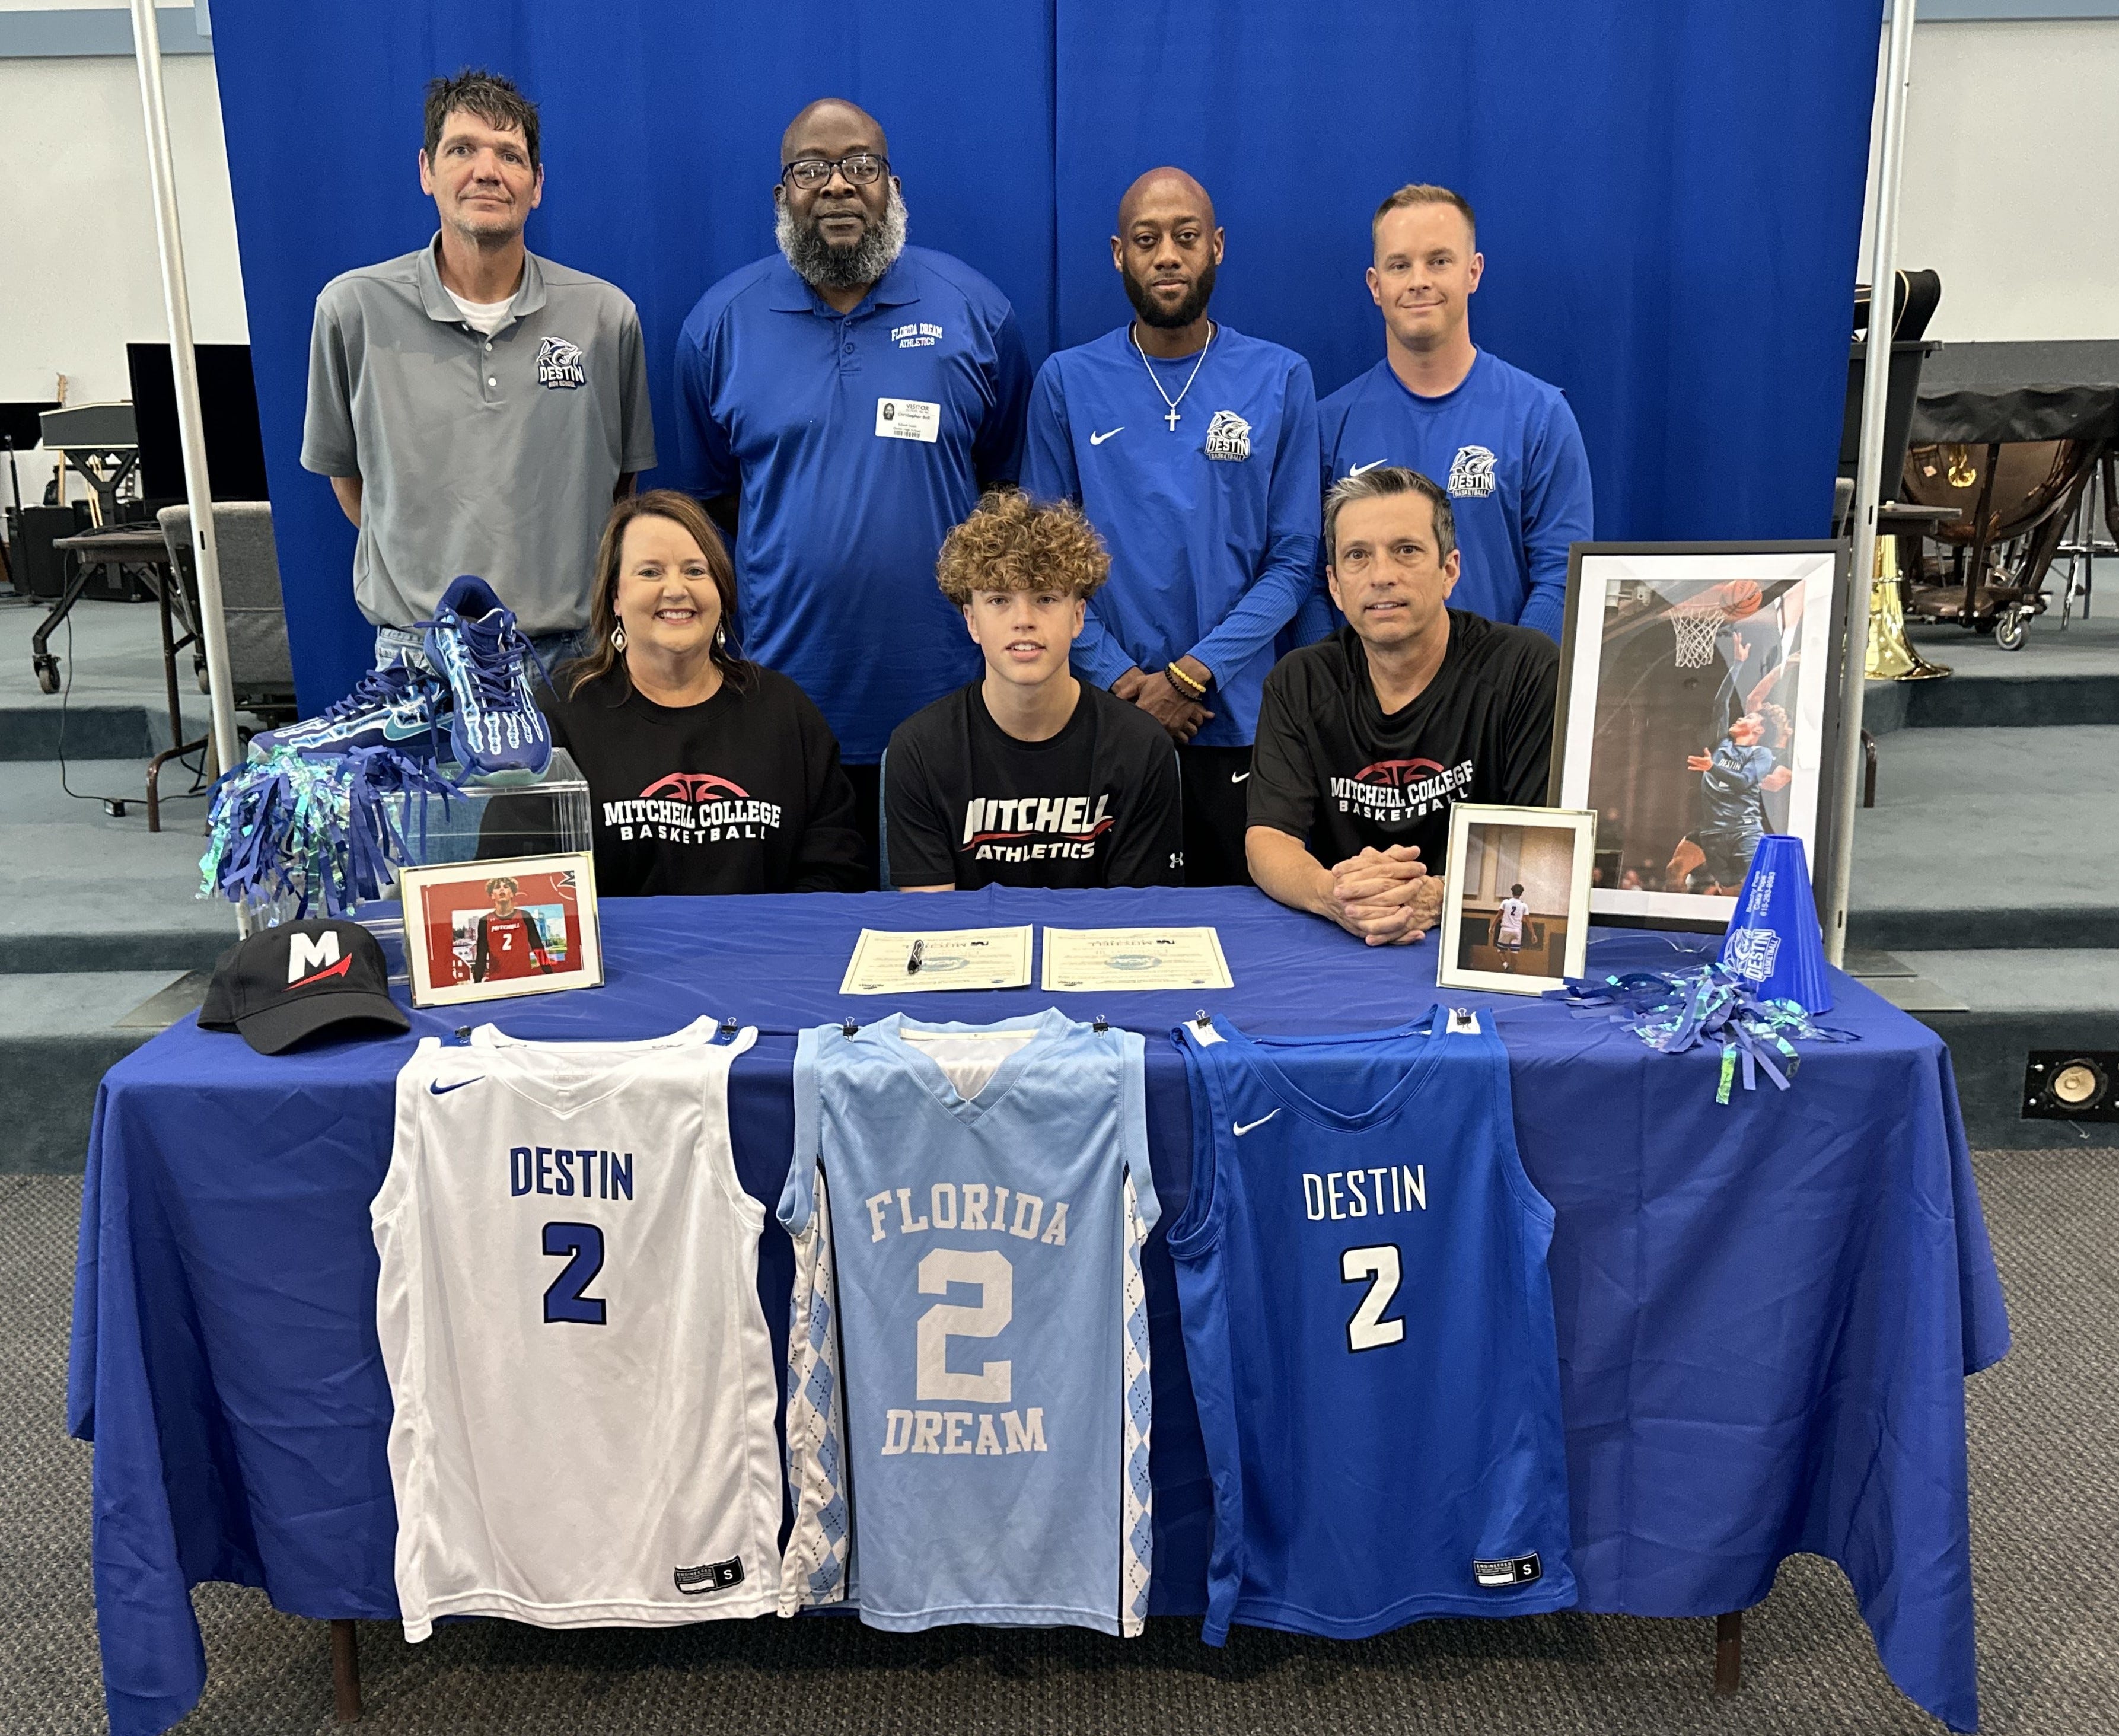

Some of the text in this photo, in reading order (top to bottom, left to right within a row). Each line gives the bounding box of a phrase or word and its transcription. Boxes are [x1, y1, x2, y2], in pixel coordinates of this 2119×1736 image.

[891, 323, 942, 341] FLORIDA DREAM
[899, 337, 935, 348] ATHLETICS
[540, 365, 584, 383] DESTIN
[1206, 438, 1248, 457] DESTIN
[1449, 473, 1493, 491] DESTIN
[1717, 758, 1742, 771] DESTIN
[1330, 777, 1406, 807] MITCHELL
[603, 800, 782, 829] MITCHELL COLLEGE
[1339, 787, 1468, 821] BASKETBALL
[620, 824, 765, 844] BASKETBALL
[975, 841, 1095, 862] ATHLETICS
[1510, 906, 1516, 916] 2
[491, 923, 520, 932] MITCHELL
[502, 933, 512, 951] 2
[288, 931, 340, 983] M
[1745, 931, 1773, 980] DESTIN
[510, 1147, 633, 1200] DESTIN
[1303, 1165, 1426, 1220] DESTIN
[865, 1183, 1069, 1246] FLORIDA
[542, 1222, 606, 1325] 2
[1340, 1243, 1406, 1354] 2
[917, 1248, 1012, 1403] 2
[881, 1407, 1048, 1455] DREAM
[723, 1569, 733, 1580] S
[1522, 1564, 1532, 1575] S
